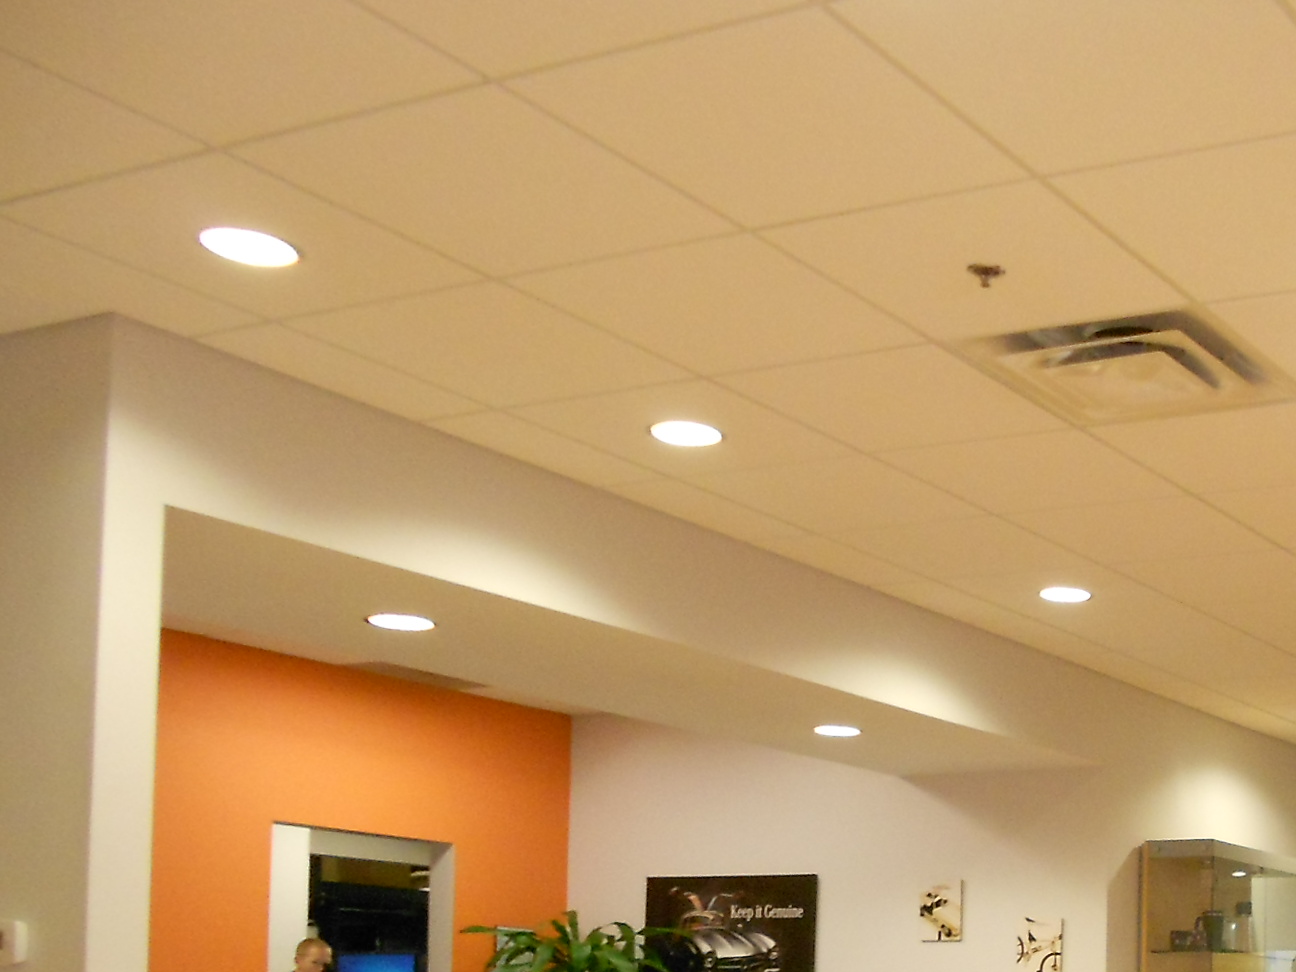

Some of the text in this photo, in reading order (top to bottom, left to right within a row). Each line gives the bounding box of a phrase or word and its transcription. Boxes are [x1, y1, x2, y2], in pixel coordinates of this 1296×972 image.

[731, 904, 804, 921] Keep it Genuine
